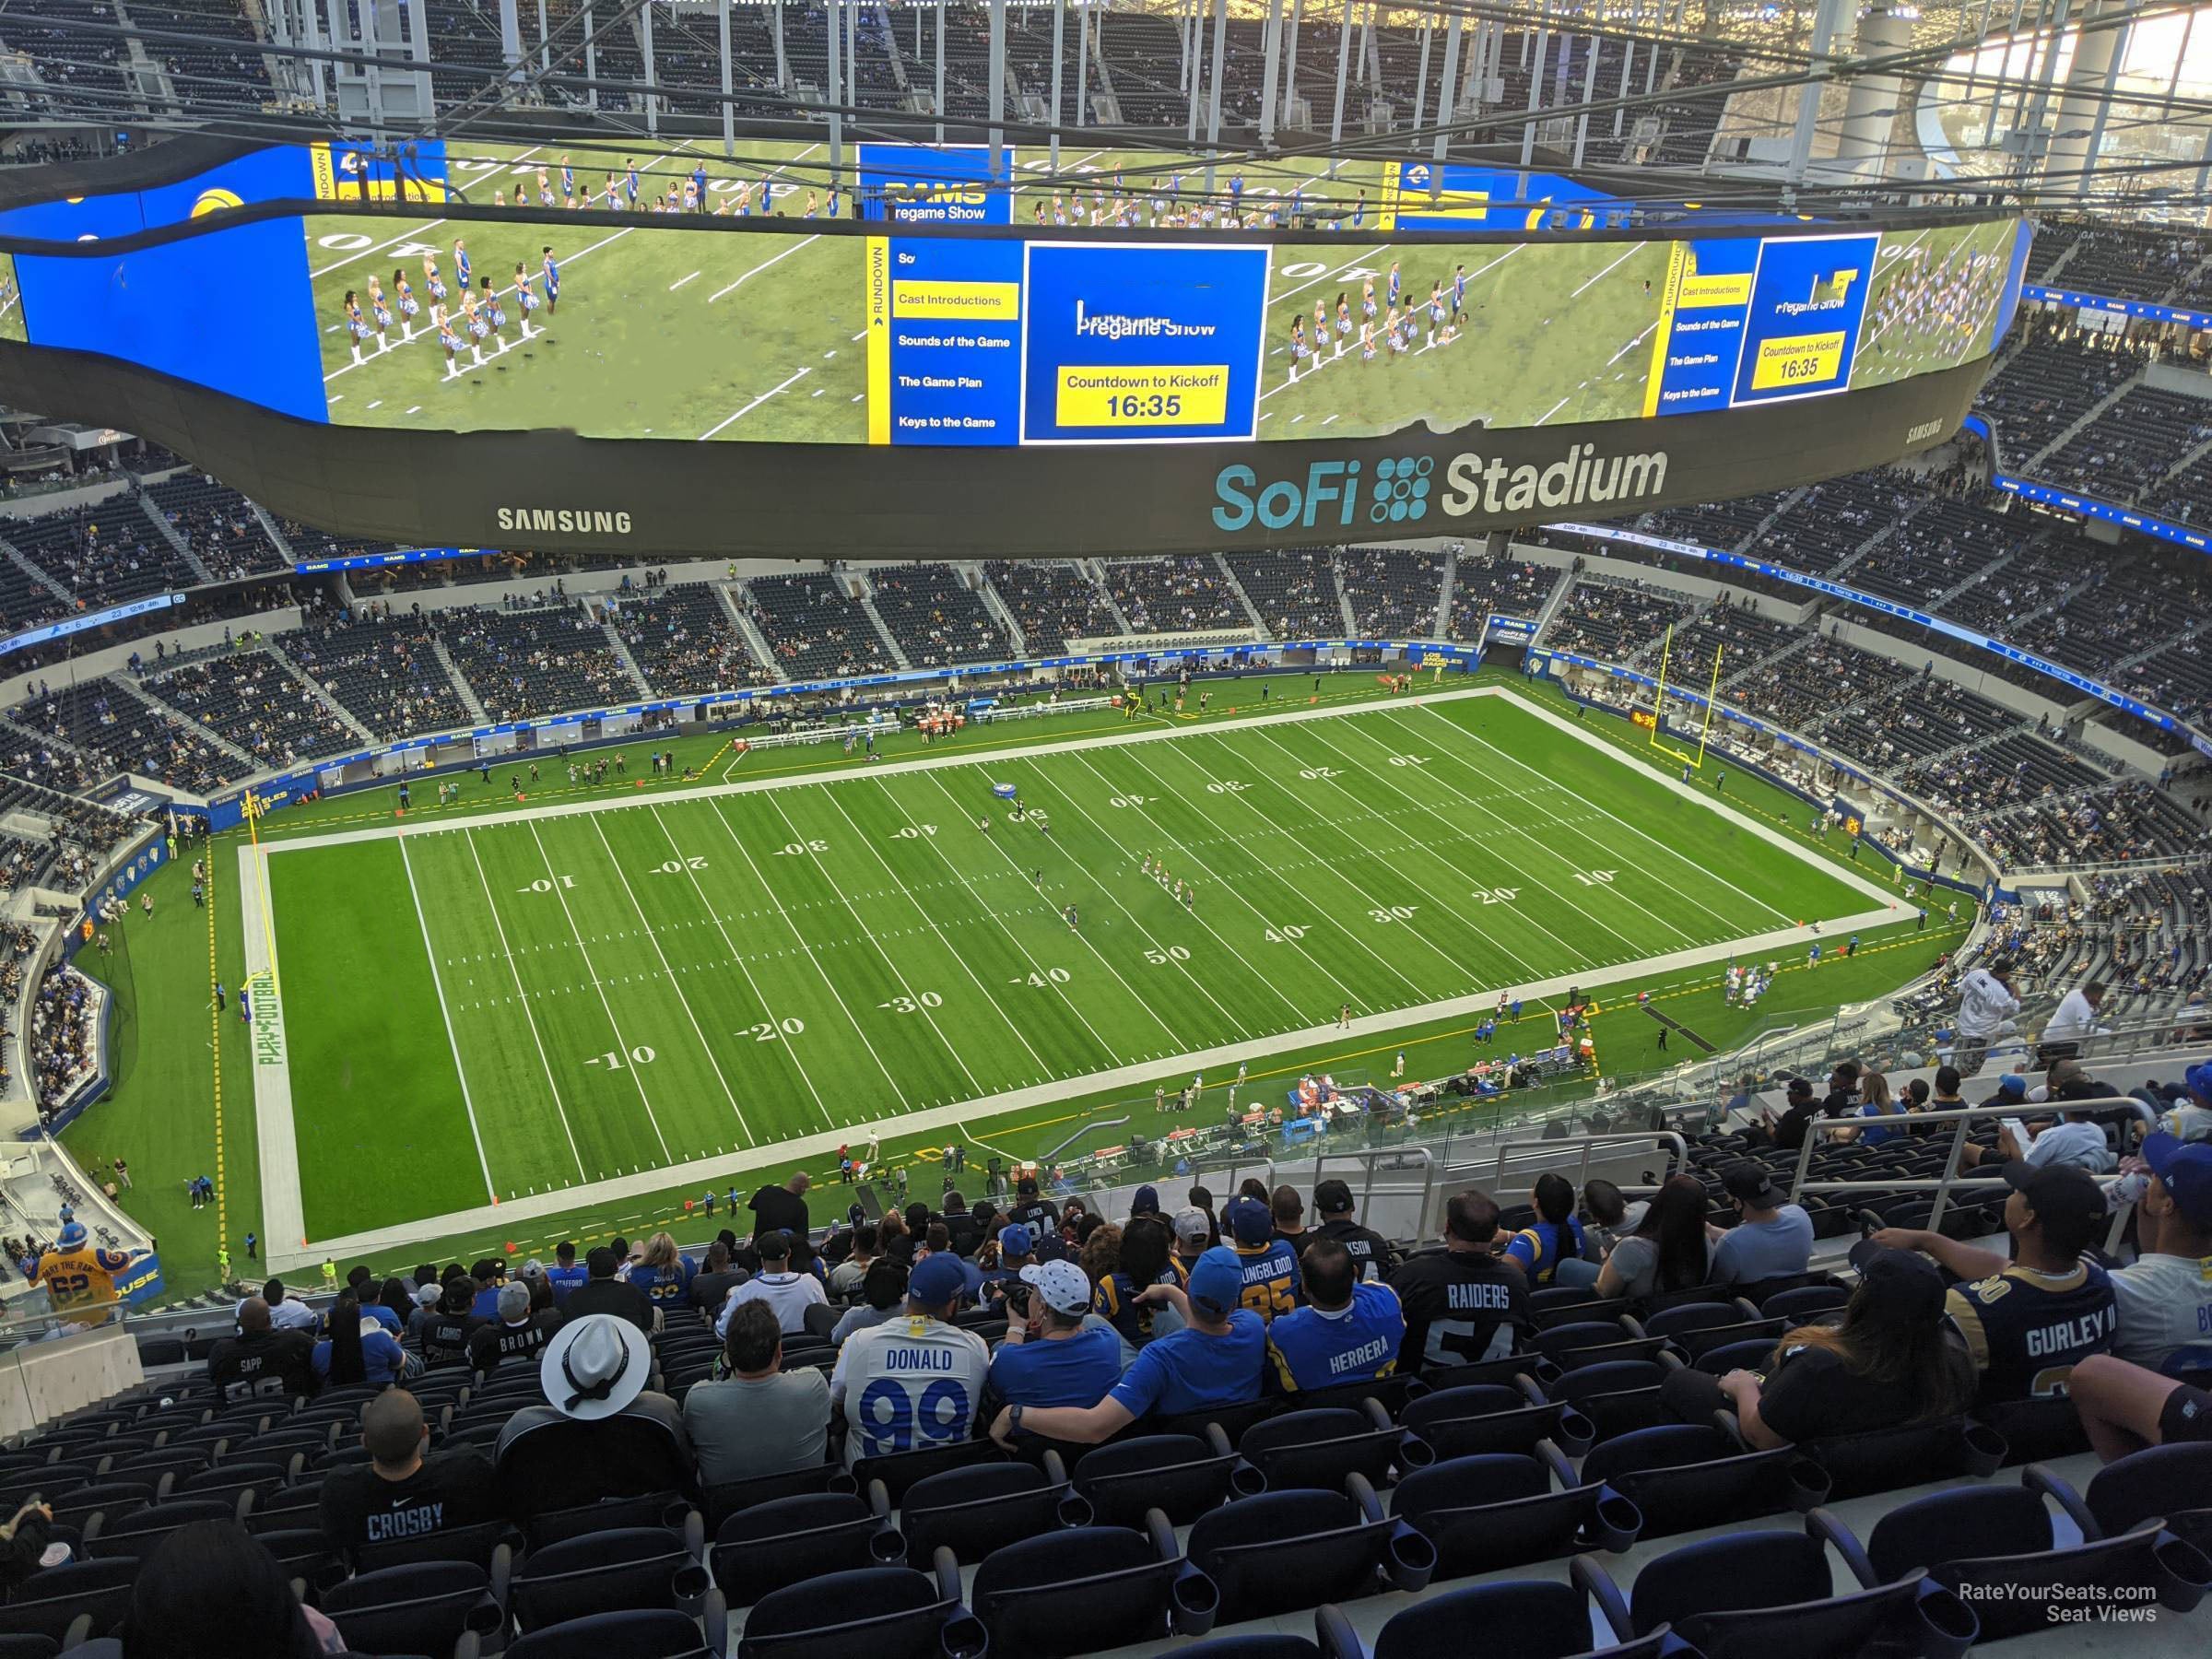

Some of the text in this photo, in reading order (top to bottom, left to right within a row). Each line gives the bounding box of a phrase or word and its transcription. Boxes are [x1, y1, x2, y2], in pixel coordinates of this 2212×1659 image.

[895, 206, 986, 222] regame Show
[873, 246, 884, 314] RUNDOWN
[898, 293, 1002, 306] Cast Introductions
[1682, 286, 1741, 297] Cast Introductions
[1676, 319, 1740, 332] Sounds of the Game
[898, 335, 1011, 348] Sounds of the Game
[1763, 339, 1841, 358] Countdown to Kickoff
[1669, 354, 1719, 366] The Game Plan
[1781, 358, 1819, 380] 16:35
[898, 376, 983, 388] The Game Plan
[1066, 374, 1219, 388] Countdown to Kickoff
[1663, 387, 1720, 402] Keys to the Game
[1107, 394, 1182, 418] 16:35
[898, 416, 996, 429] Keys to the Game
[1212, 442, 1669, 532] SoFi Stadium
[497, 507, 632, 534] SAMSUNG
[111, 610, 123, 619] 23
[60, 1261, 76, 1271] THE
[1240, 1256, 1293, 1285] UNGBLOOD
[555, 1278, 583, 1288] STAFFORD
[1448, 1283, 1511, 1309] RAIDERS
[2026, 1302, 2117, 1358] GURLEY II
[500, 1326, 544, 1353] BROWN
[886, 1349, 953, 1371] DONALD
[1328, 1335, 1389, 1375] HERRERA
[241, 1356, 263, 1373] SAPP
[859, 1378, 970, 1458] 99
[368, 1502, 443, 1542] CROSBY
